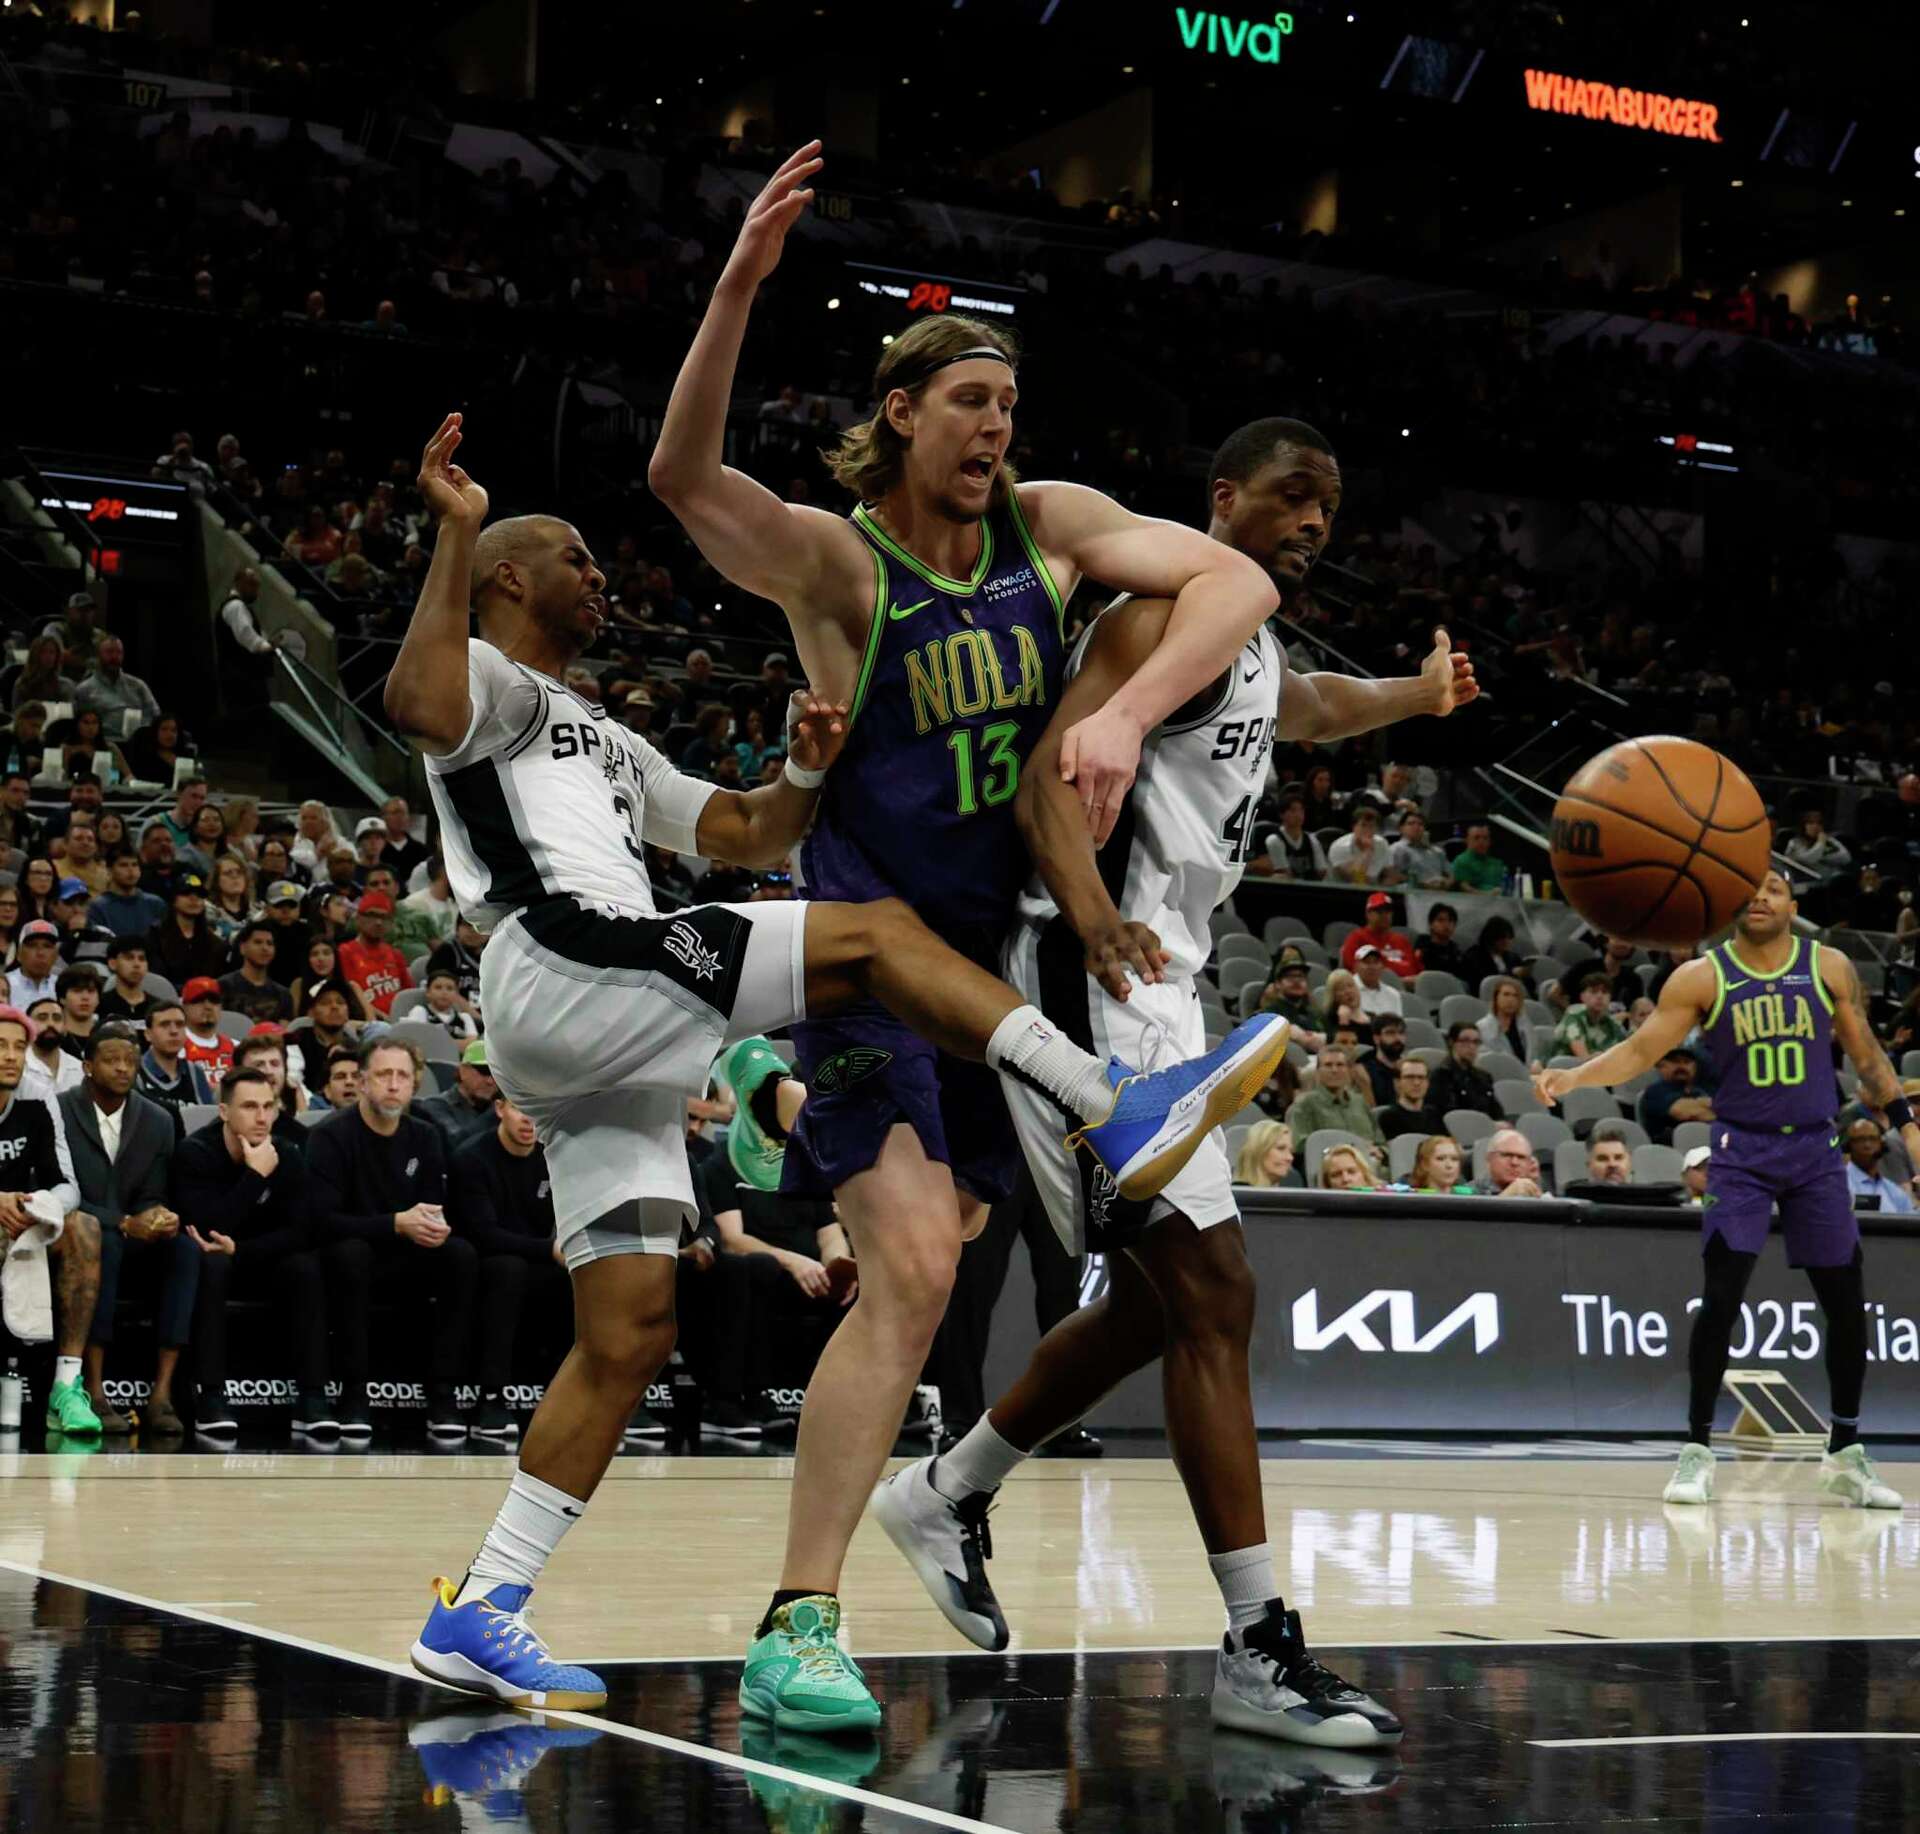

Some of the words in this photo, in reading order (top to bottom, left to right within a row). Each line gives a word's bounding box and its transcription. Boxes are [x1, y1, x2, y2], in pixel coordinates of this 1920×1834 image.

[125, 83, 162, 108] 107
[1524, 68, 1722, 143] WHATABURGER
[983, 568, 1033, 594] NEWAGE
[987, 580, 1037, 602] PRODUCTS
[904, 625, 1046, 734] NOLA
[947, 719, 1021, 815] 13
[613, 794, 644, 862] 3
[1731, 994, 1815, 1046] NOLA
[1747, 1041, 1806, 1087] 00
[1292, 1287, 1499, 1354] KIA
[1561, 1294, 1668, 1358] The
[1687, 1297, 1821, 1361] 025
[1863, 1302, 1919, 1362] ia
[223, 1379, 299, 1397] RCODE
